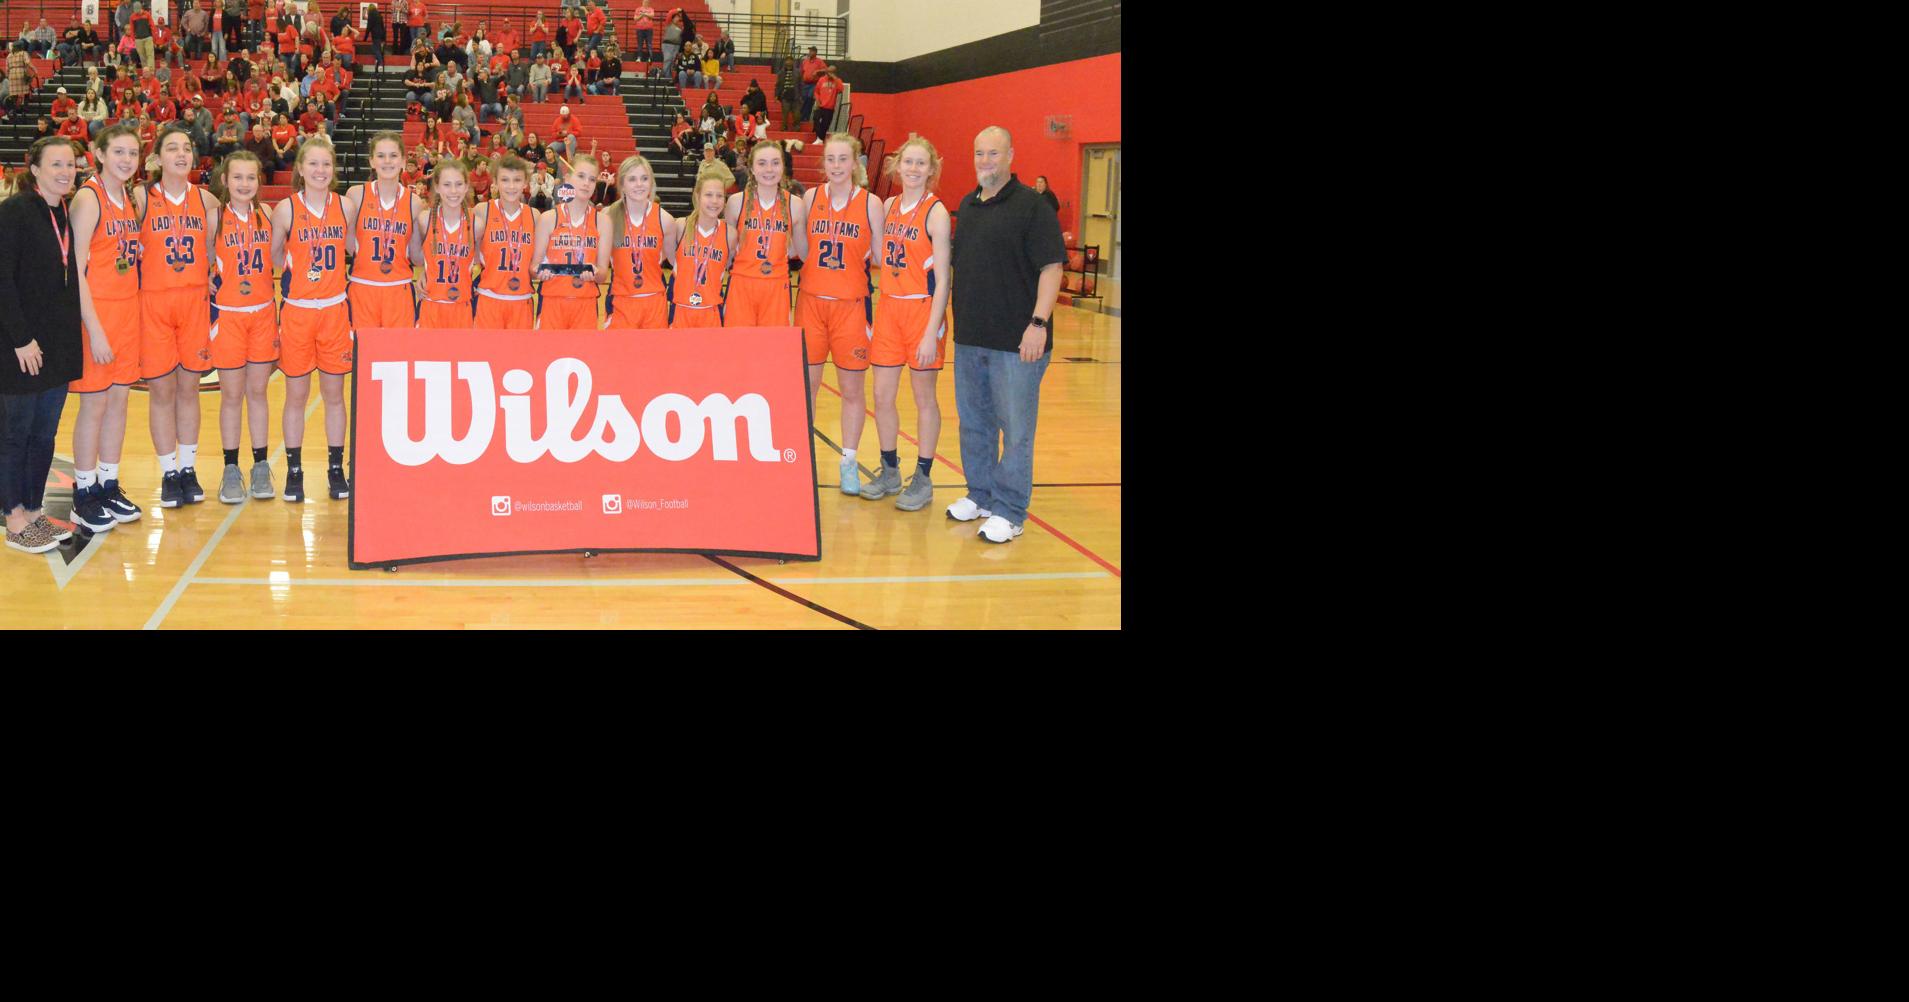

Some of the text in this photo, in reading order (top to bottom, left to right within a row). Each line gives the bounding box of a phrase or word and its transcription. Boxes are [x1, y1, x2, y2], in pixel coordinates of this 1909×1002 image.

[385, 219, 407, 235] RMS
[765, 218, 787, 232] RMS
[251, 230, 269, 242] AMS
[576, 235, 597, 249] RMS
[165, 236, 195, 265] 33
[818, 240, 845, 270] 21
[371, 357, 781, 466] Wilson
[514, 500, 583, 512] @wilsonbasketball
[626, 498, 689, 510] @Wilson_Football
